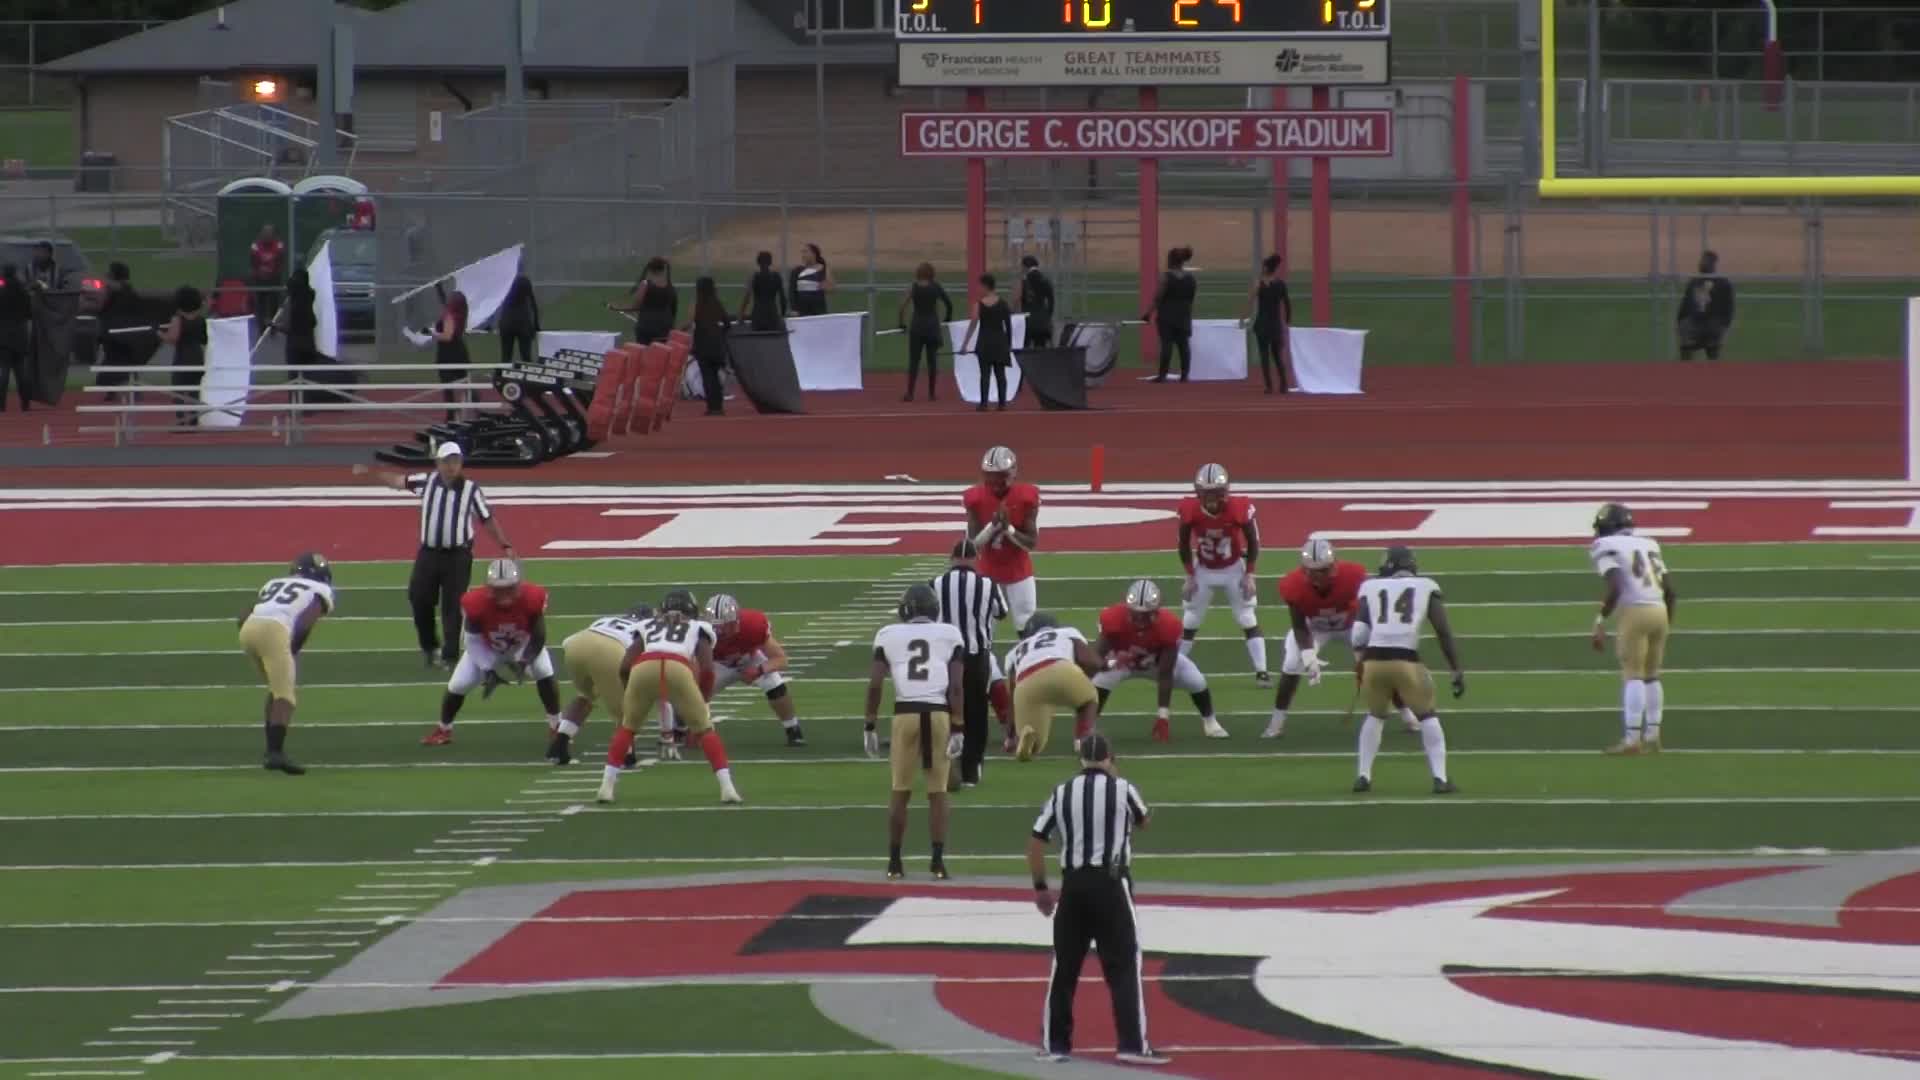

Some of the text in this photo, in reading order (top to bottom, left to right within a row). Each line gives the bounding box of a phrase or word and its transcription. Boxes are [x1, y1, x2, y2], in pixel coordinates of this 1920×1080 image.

[900, 13, 947, 32] T.O.L.
[1337, 11, 1385, 29] T.O.L.
[942, 53, 1002, 65] Franciscan
[1064, 51, 1221, 65] GREAT TEAMMATES
[1064, 65, 1221, 76] MAKE ALL THE DIFFERENCE
[919, 117, 1374, 149] GEORGE C. GROSSKOPF STADIUM
[1197, 536, 1232, 561] 24
[257, 581, 312, 606] 95
[1377, 587, 1417, 624] 14
[645, 619, 690, 645] 28
[907, 638, 931, 682] 2
